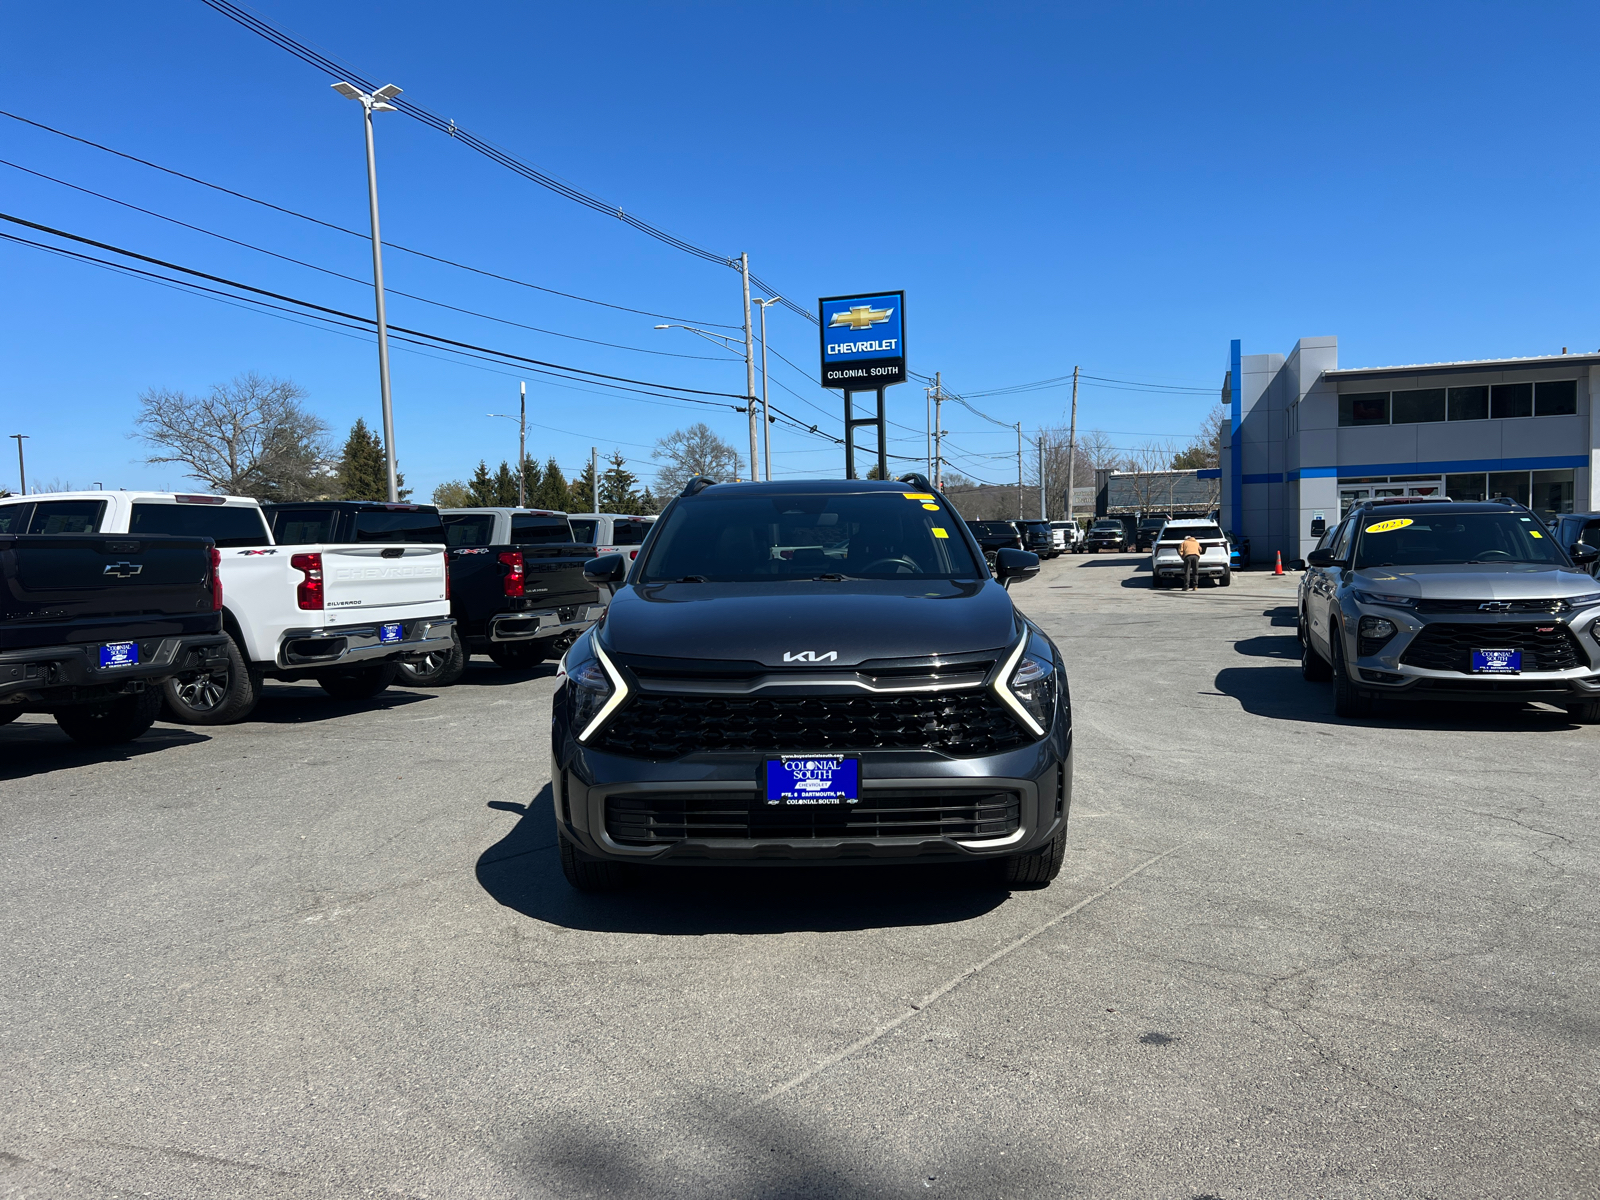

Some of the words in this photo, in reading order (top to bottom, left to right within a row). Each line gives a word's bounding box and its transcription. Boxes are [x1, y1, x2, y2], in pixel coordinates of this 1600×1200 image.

[827, 339, 897, 354] CHEVROLET
[827, 369, 868, 379] COLONIAL
[870, 366, 899, 376] SOUTH
[336, 565, 441, 580] CHEVROLET
[783, 651, 838, 662] KIA
[784, 761, 841, 771] COLONIAL
[793, 770, 832, 780] SOUTH
